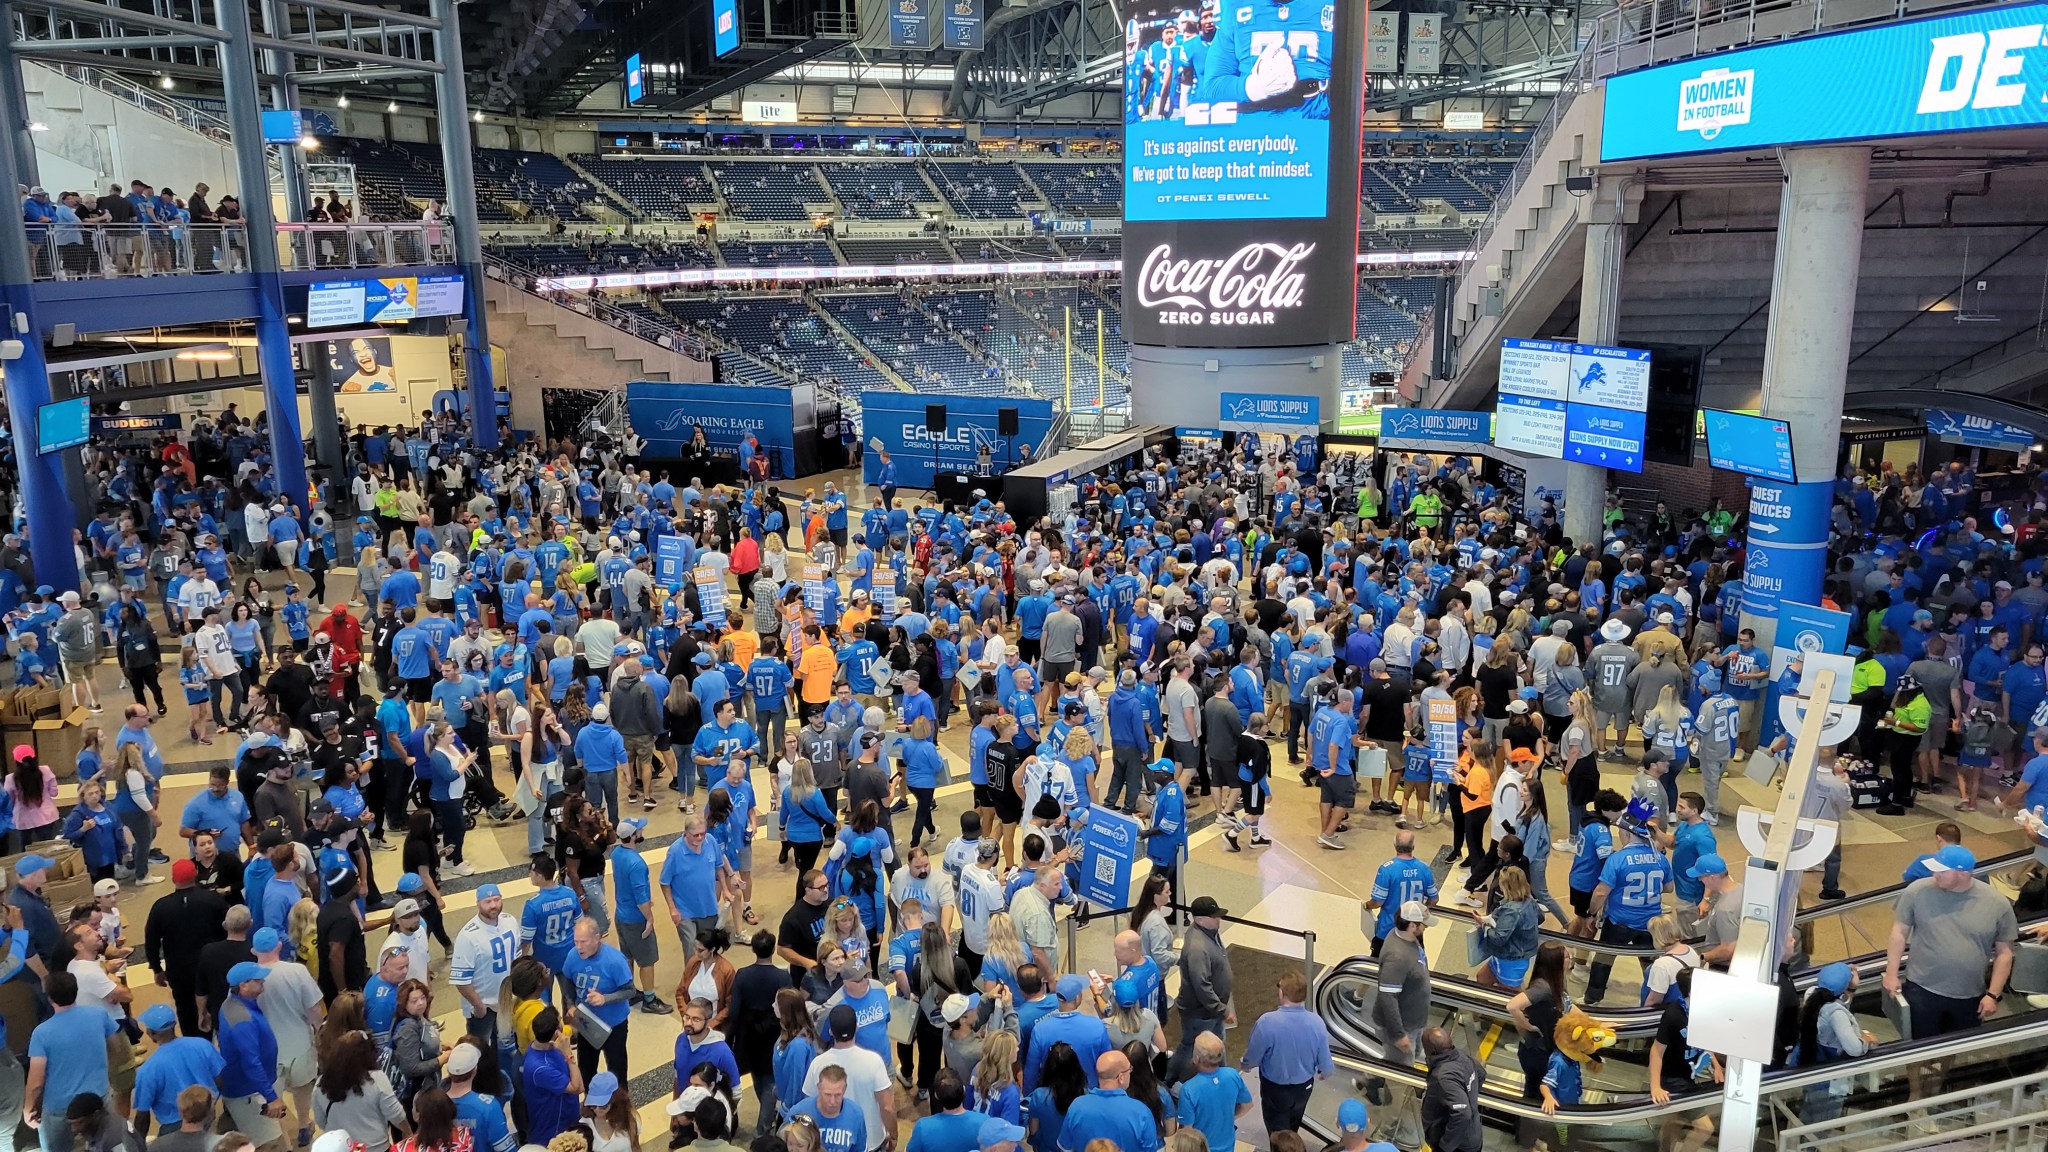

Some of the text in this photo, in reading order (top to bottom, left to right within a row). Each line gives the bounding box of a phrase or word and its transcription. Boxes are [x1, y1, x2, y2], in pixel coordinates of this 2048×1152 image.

[1916, 23, 2048, 115] DE
[1686, 78, 1746, 103] WOMEN
[760, 105, 780, 119] Lite
[1684, 102, 1745, 120] IN FOOTBALL
[1143, 134, 1298, 158] It's us against everybody.
[1133, 160, 1312, 184] We've got to keep that mindset.
[1174, 194, 1212, 202] PENEI
[1217, 193, 1270, 202] SEWELL
[1053, 221, 1086, 232] LIONS
[1137, 242, 1316, 309] Coca-Cola
[1160, 311, 1274, 325] ZERO SUGAR
[1257, 400, 1308, 414] LIONS SUPPLY
[102, 416, 165, 429] BUD LIGHT
[681, 415, 764, 431] SOARING EAGLE
[1421, 415, 1478, 430] LIONS SUPPLY
[903, 423, 969, 442] EAGLE
[1570, 432, 1638, 450] LIONS SUPPLY NOW OPEN
[1855, 432, 1889, 440] COCKTAILS
[903, 440, 932, 449] CASINO
[940, 442, 970, 452] SPORTS
[924, 461, 978, 471] DREAM SEAT
[1712, 457, 1728, 465] CURE
[1146, 481, 1158, 492] 81
[1752, 486, 1782, 502] GUEST
[1749, 499, 1792, 519] ERVICES
[164, 555, 178, 572] 97
[430, 562, 445, 579] 20
[696, 568, 716, 578] 50/50
[1750, 574, 1782, 592] SUPPLY
[1119, 587, 1134, 605] 94
[83, 625, 94, 644] 16
[378, 629, 388, 646] 7
[401, 640, 415, 657] 97
[1294, 666, 1300, 683] 9
[1604, 664, 1624, 685] 97
[756, 676, 773, 696] 97
[1431, 704, 1454, 715] 50/50
[1316, 719, 1327, 741] 91
[1715, 712, 1739, 742] 20
[366, 737, 377, 757] 5
[812, 740, 833, 763] 23
[988, 748, 1005, 760] SANDERS
[1409, 757, 1424, 772] 97
[988, 758, 1005, 792] 20
[1635, 855, 1661, 866] SANDE
[1403, 868, 1418, 879] GOFF
[962, 874, 982, 892] JOHNSON
[1400, 881, 1425, 902] 16
[1623, 871, 1663, 907] 20
[542, 898, 574, 912] HUTCHINSON
[961, 893, 977, 922] 81
[810, 918, 825, 938] LIO
[490, 930, 516, 973] 97
[376, 986, 390, 997] 97
[820, 1128, 852, 1147] TROIT
